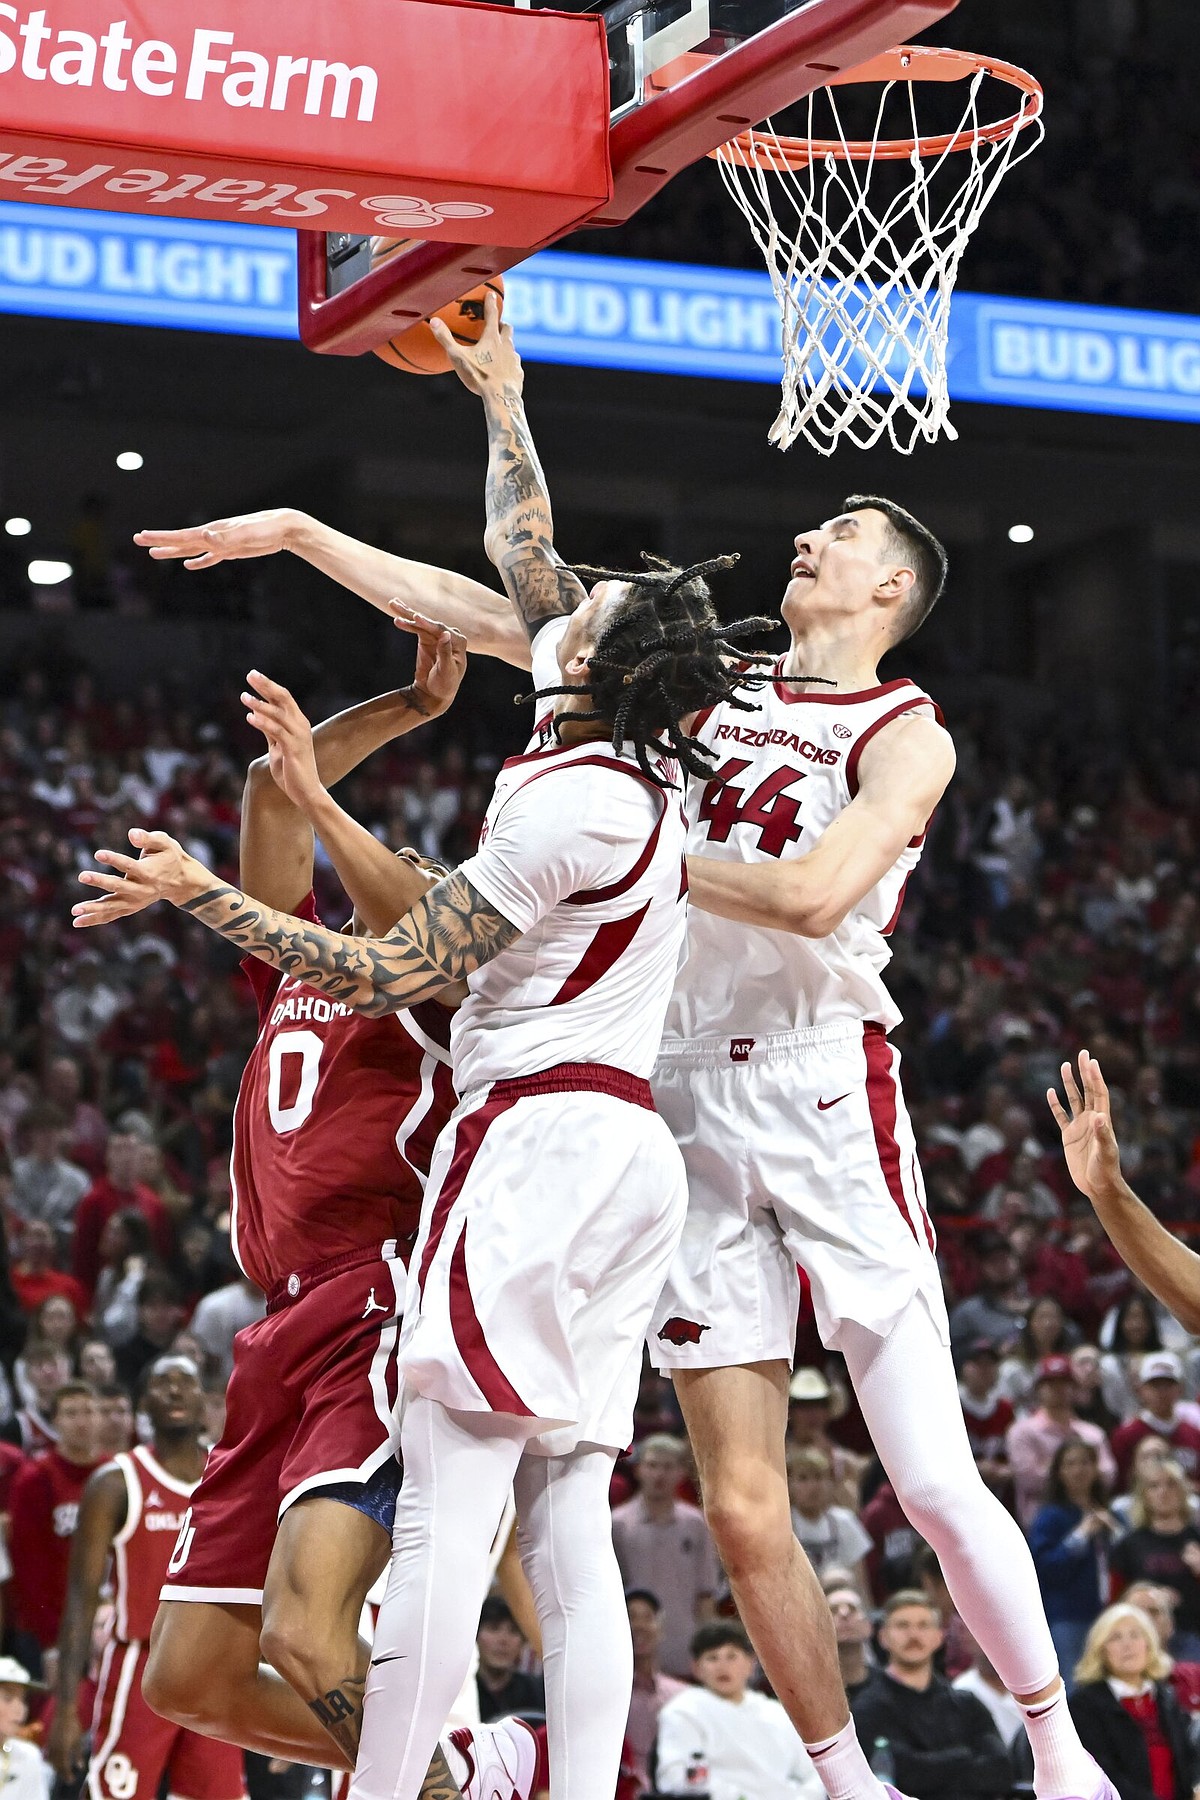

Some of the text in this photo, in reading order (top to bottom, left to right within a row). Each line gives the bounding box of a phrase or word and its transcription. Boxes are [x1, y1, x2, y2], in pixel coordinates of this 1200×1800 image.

[184, 28, 379, 122] Farm
[0, 153, 356, 217] State Fa
[0, 227, 290, 306] UD LIGHT
[502, 274, 624, 336] BUD
[992, 324, 1114, 384] BUD
[697, 756, 808, 859] 44
[267, 1030, 325, 1135] 0
[732, 1044, 751, 1055] AR
